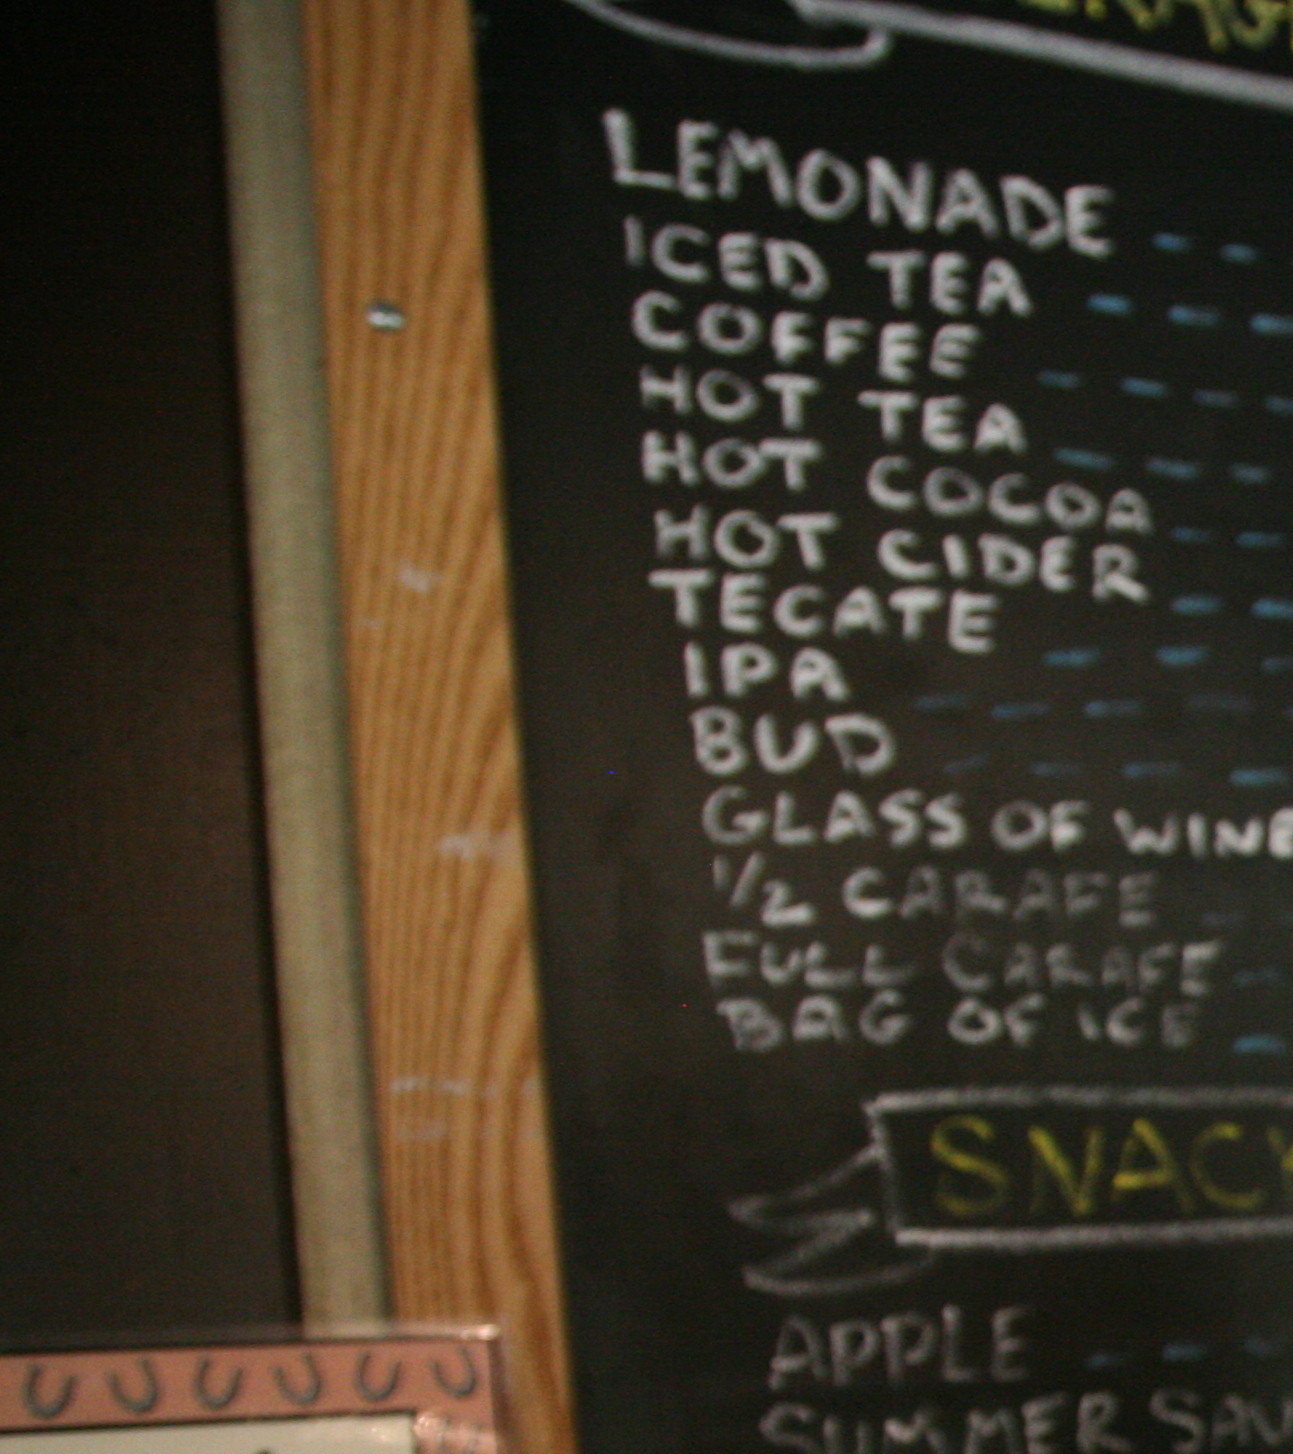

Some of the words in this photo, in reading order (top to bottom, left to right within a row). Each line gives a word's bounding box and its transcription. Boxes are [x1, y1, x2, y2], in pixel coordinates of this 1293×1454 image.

[602, 107, 1113, 257] LEMONADE
[624, 215, 830, 299] ICED
[866, 249, 1032, 317] TEA
[631, 290, 981, 382] COFFEE
[640, 364, 820, 430] HOT
[857, 390, 1028, 454] TEA
[642, 430, 823, 490] HOT
[866, 454, 1153, 535] COCOA
[655, 504, 840, 569] HOT
[877, 529, 1148, 602] CIDER
[648, 568, 998, 654] TECATE
[684, 642, 850, 700] IPA
[690, 704, 898, 776] BUD
[702, 786, 969, 849] GLASS
[990, 799, 1088, 853] OF
[711, 850, 816, 928] 1/2
[842, 864, 1160, 929] CARAFE
[703, 930, 912, 990] FULL
[942, 930, 1224, 1000] CARAFE
[716, 993, 912, 1053] BAG
[946, 992, 1046, 1049] OF
[1076, 998, 1206, 1048] ICE
[769, 1303, 1030, 1390] APPLE
